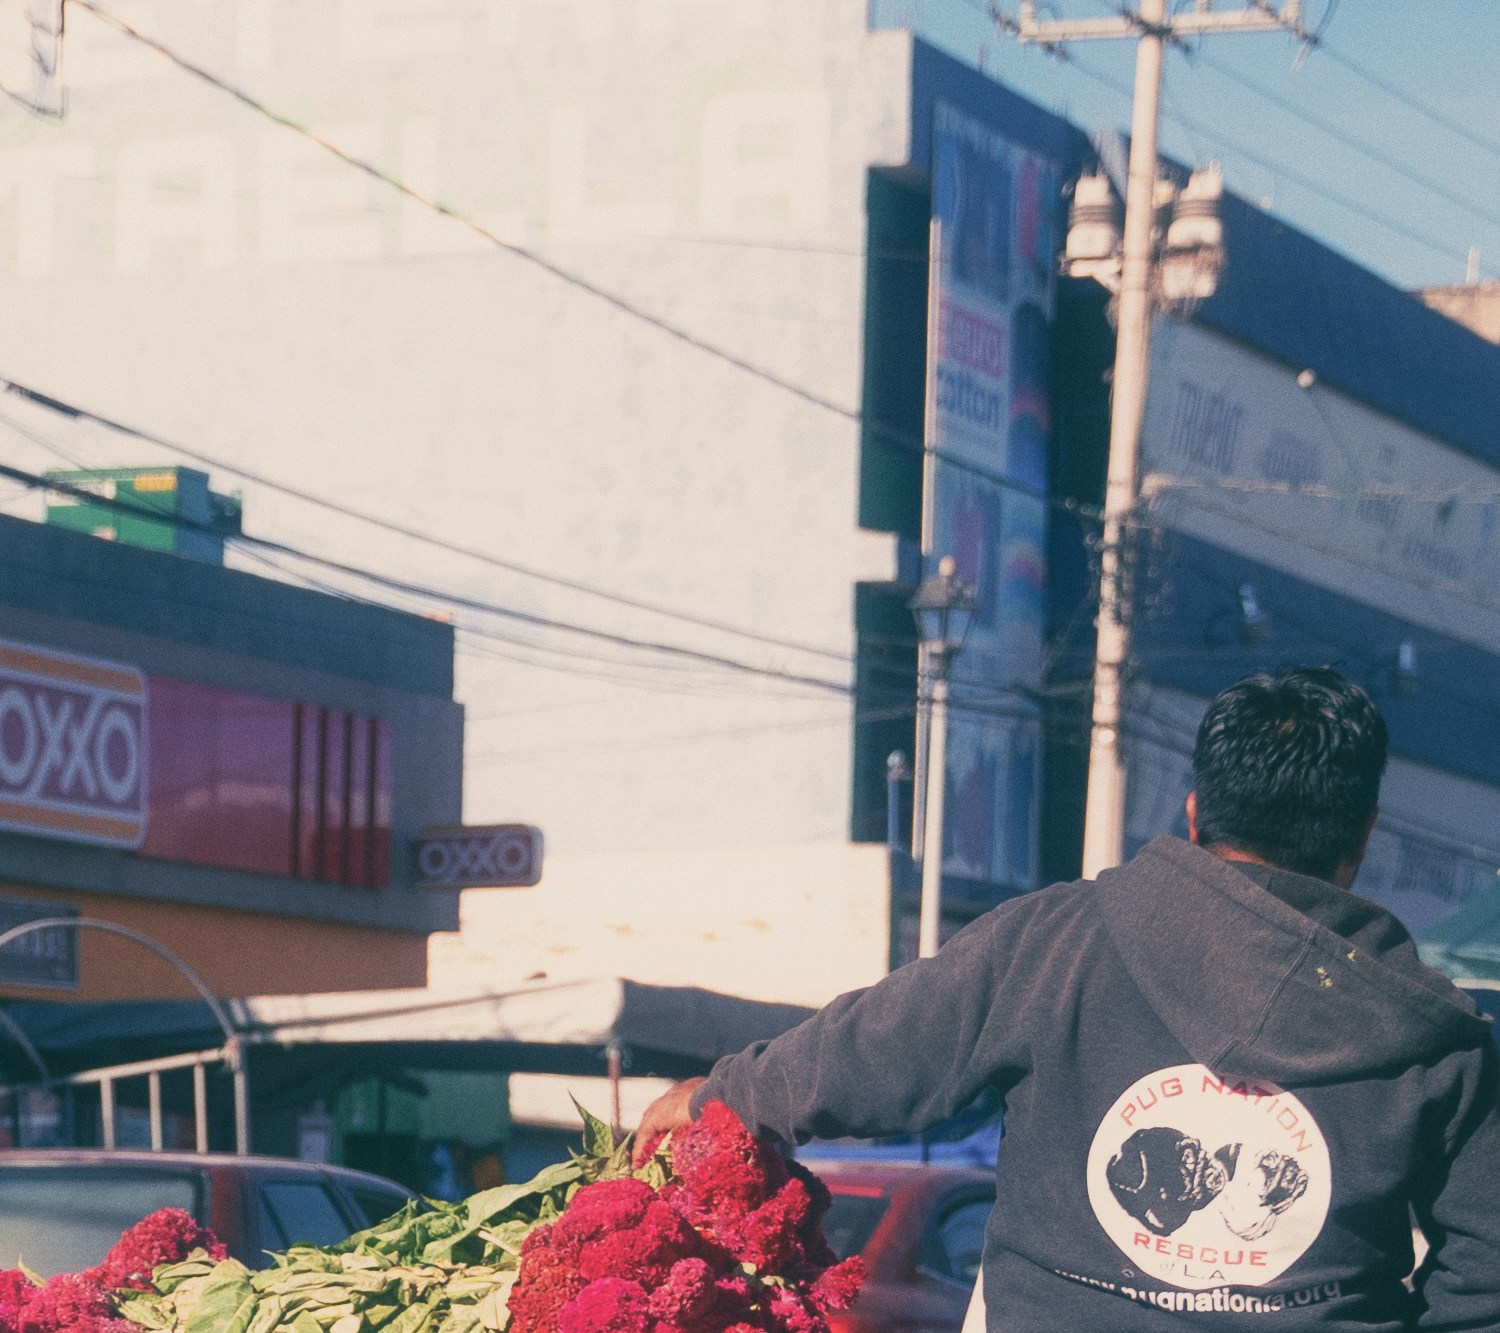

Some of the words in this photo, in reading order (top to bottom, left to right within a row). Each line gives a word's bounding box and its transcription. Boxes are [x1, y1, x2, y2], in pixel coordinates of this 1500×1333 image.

[417, 835, 530, 880] OXXO
[1119, 1077, 1184, 1127] PUG
[1201, 1074, 1314, 1153] NATION
[1133, 1232, 1268, 1266] RESCUE
